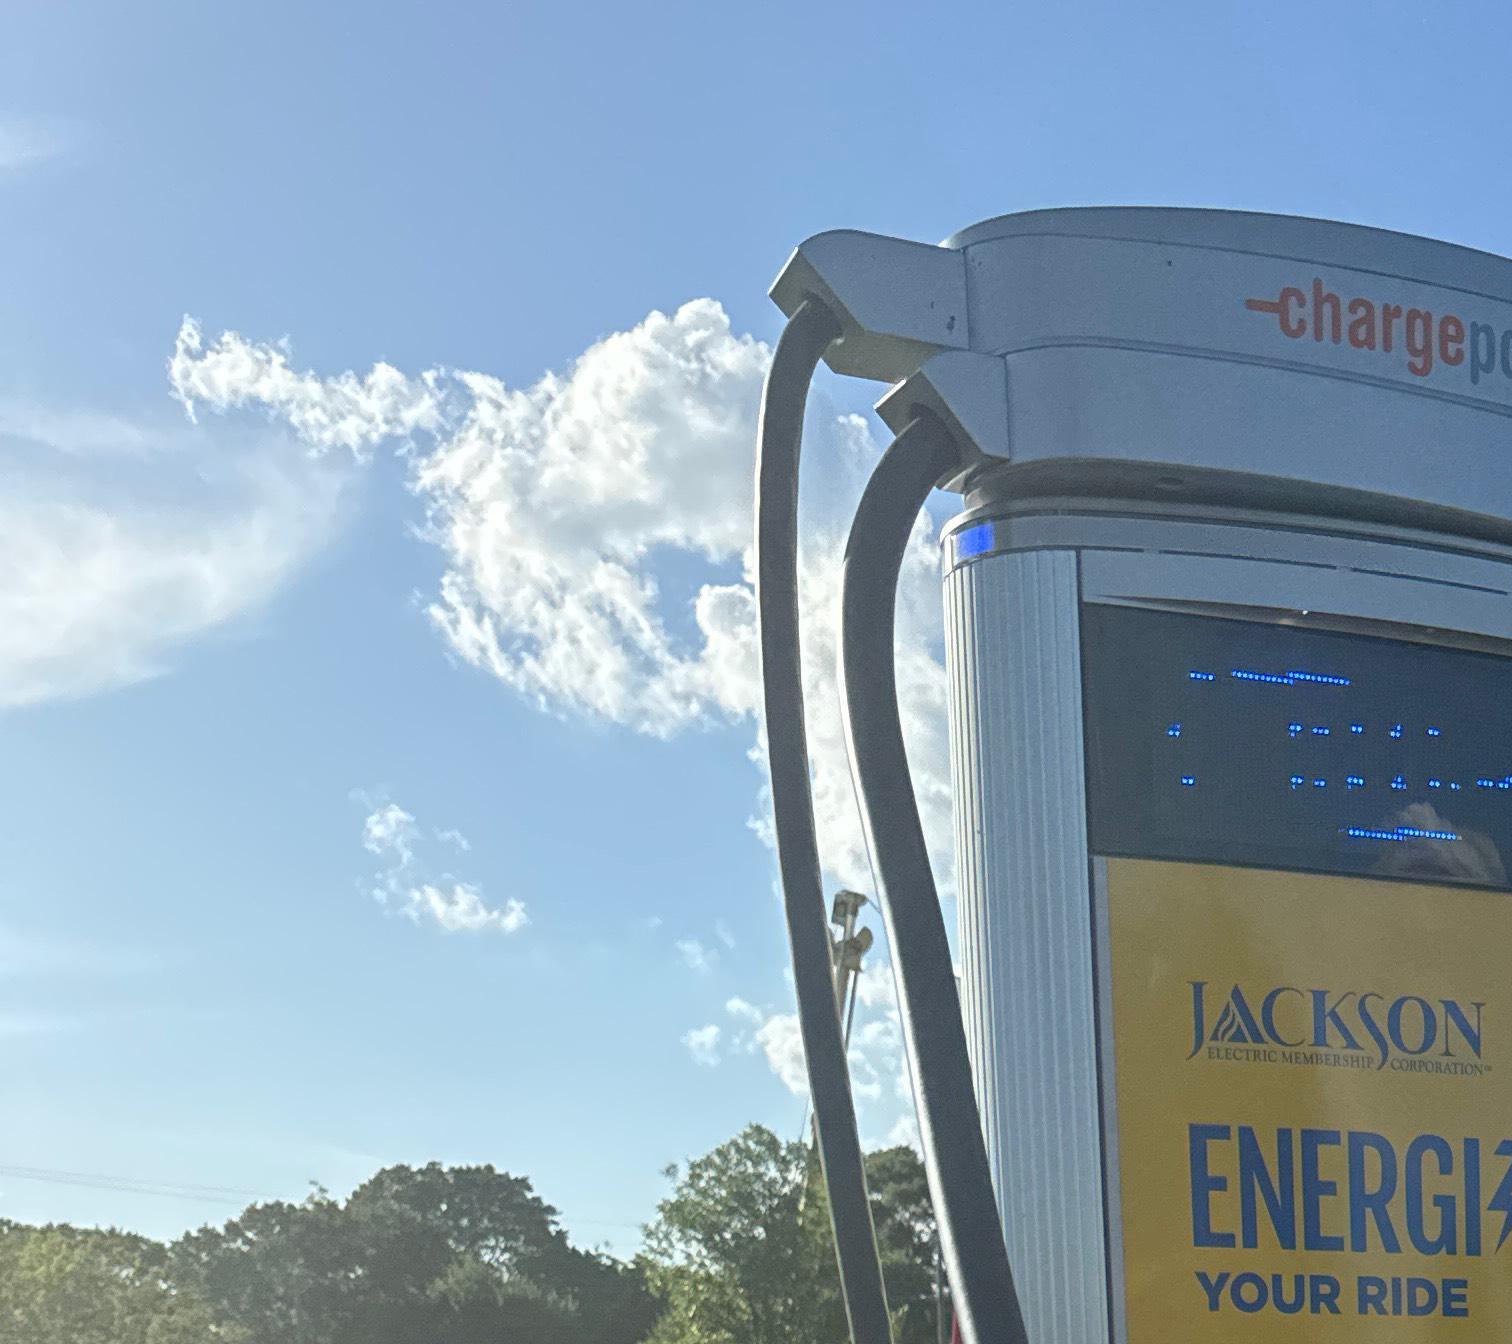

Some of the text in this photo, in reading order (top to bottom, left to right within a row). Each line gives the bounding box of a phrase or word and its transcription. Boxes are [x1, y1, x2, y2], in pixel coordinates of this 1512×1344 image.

[1186, 980, 1488, 1072] JACKSON
[1207, 1046, 1485, 1077] ELECTRIC MEMBERSHIP CORPORATION
[1195, 1270, 1470, 1319] YOUR RIDE
